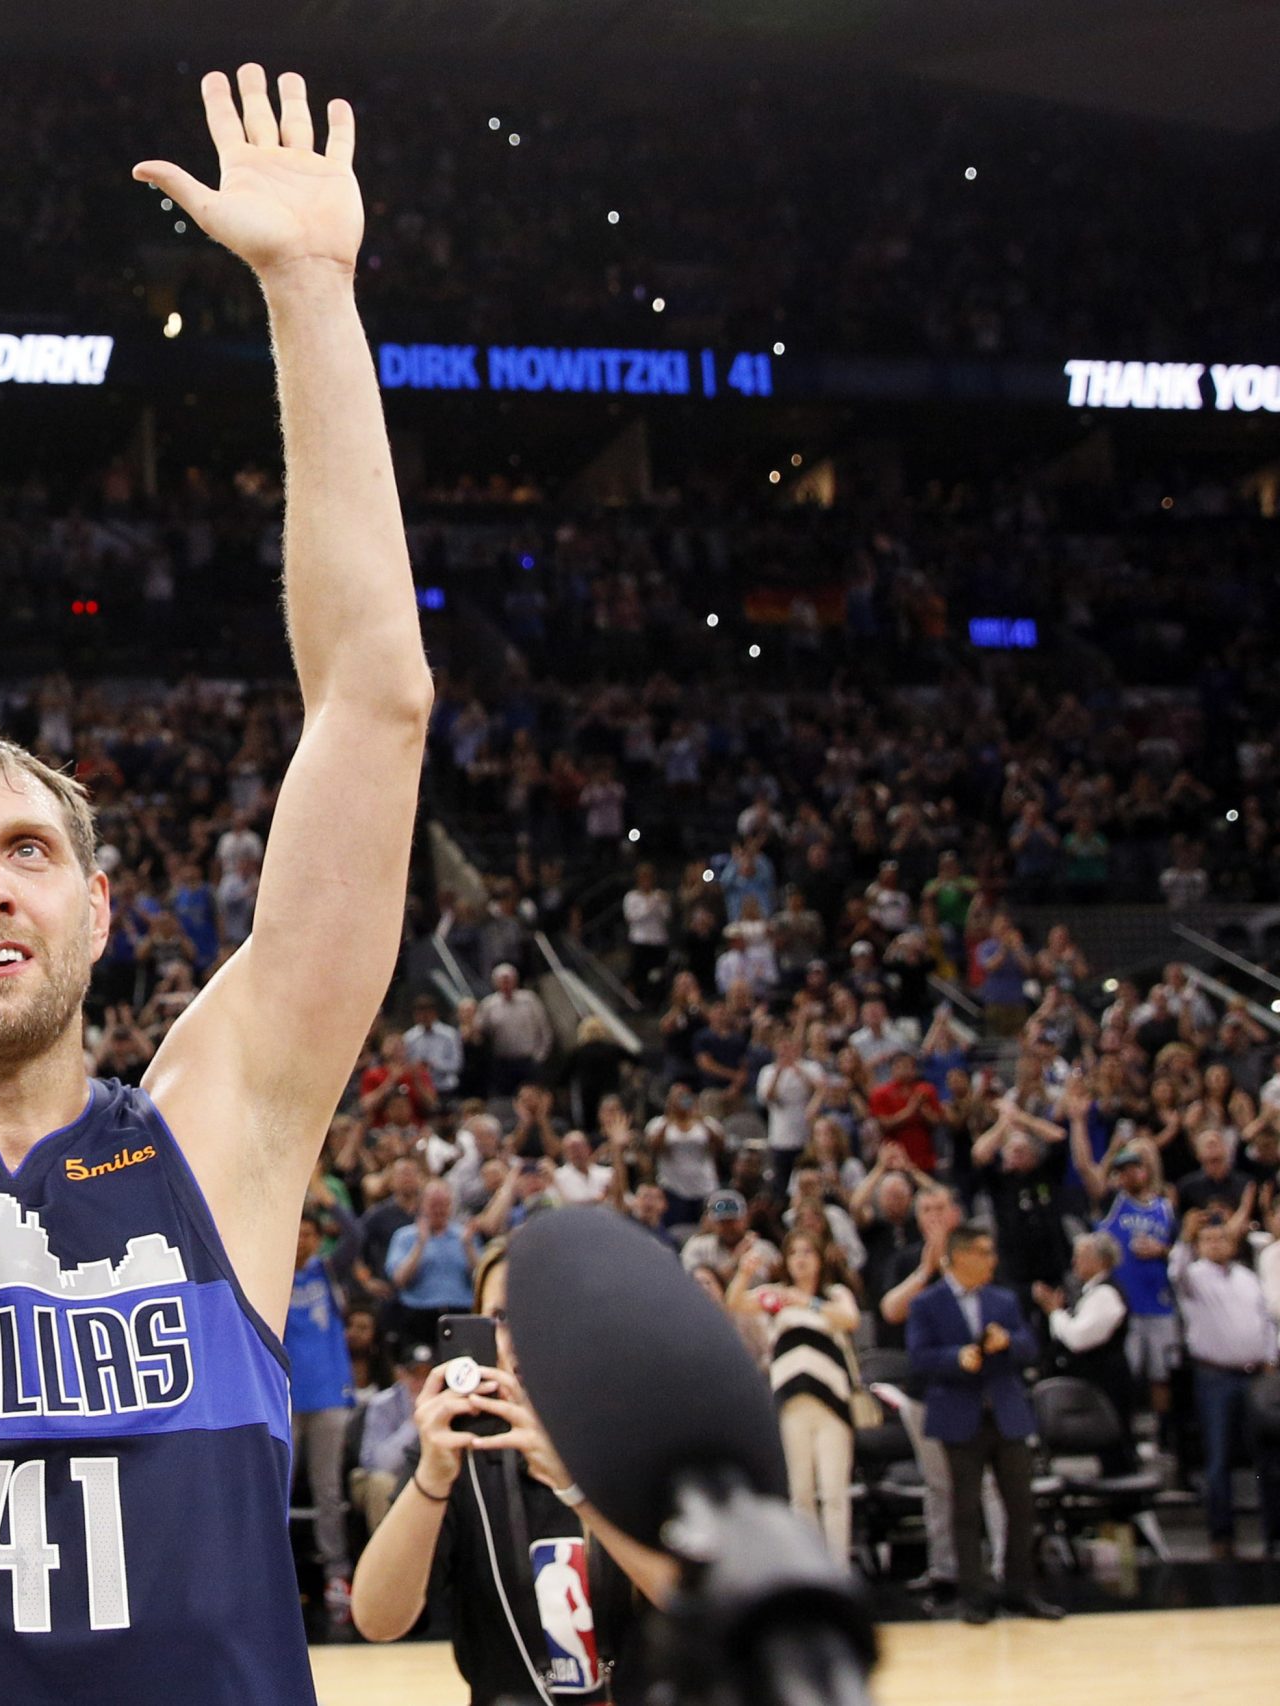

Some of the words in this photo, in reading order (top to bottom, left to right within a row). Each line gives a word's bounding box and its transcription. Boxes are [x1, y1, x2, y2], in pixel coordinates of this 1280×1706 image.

[379, 342, 480, 390] DIRK
[487, 345, 691, 395] NOWITZKI
[727, 352, 774, 397] 41
[1064, 359, 1205, 409] THANK
[65, 1145, 157, 1181] 5miles
